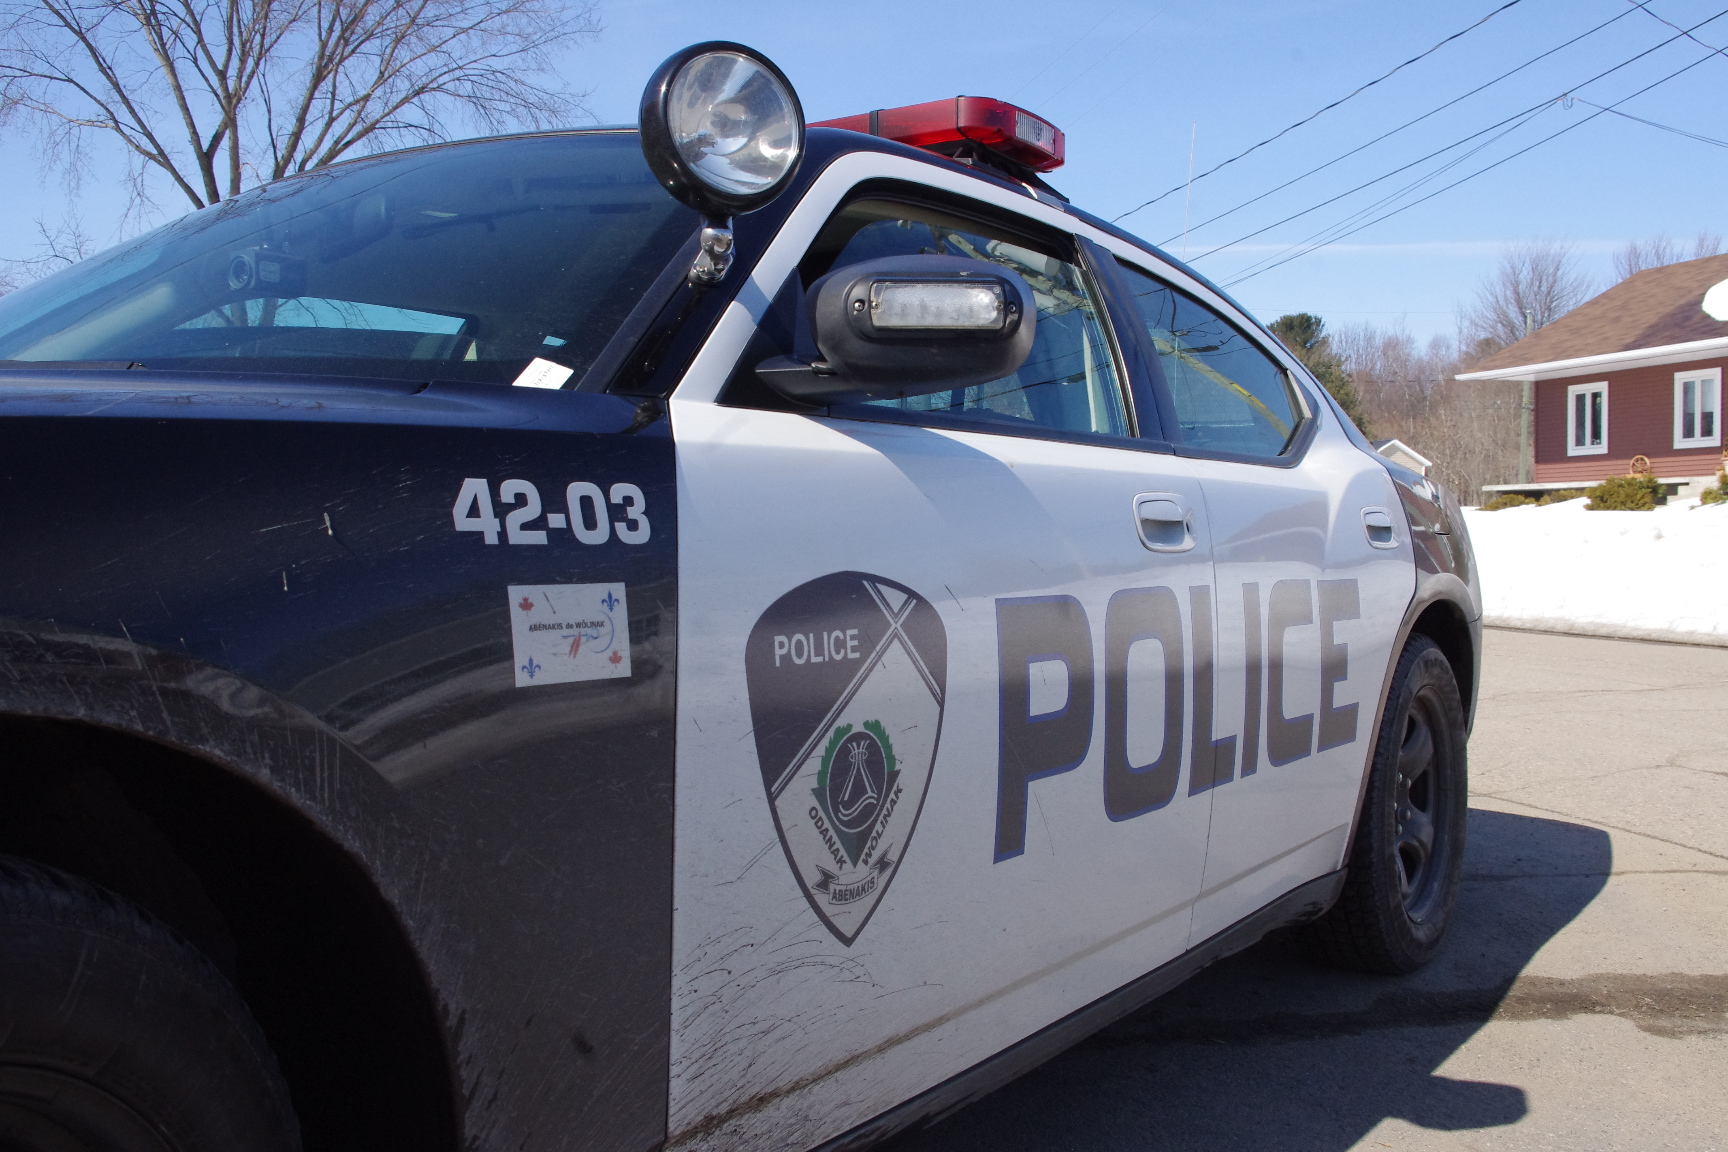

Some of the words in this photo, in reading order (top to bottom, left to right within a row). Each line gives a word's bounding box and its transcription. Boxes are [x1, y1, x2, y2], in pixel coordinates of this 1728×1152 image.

[453, 478, 650, 544] 42-03
[565, 622, 574, 630] de
[774, 629, 860, 667] POLICE
[993, 579, 1361, 864] POLICE
[808, 806, 847, 871] ODANAK
[831, 876, 875, 902] ABÉNAKIS
